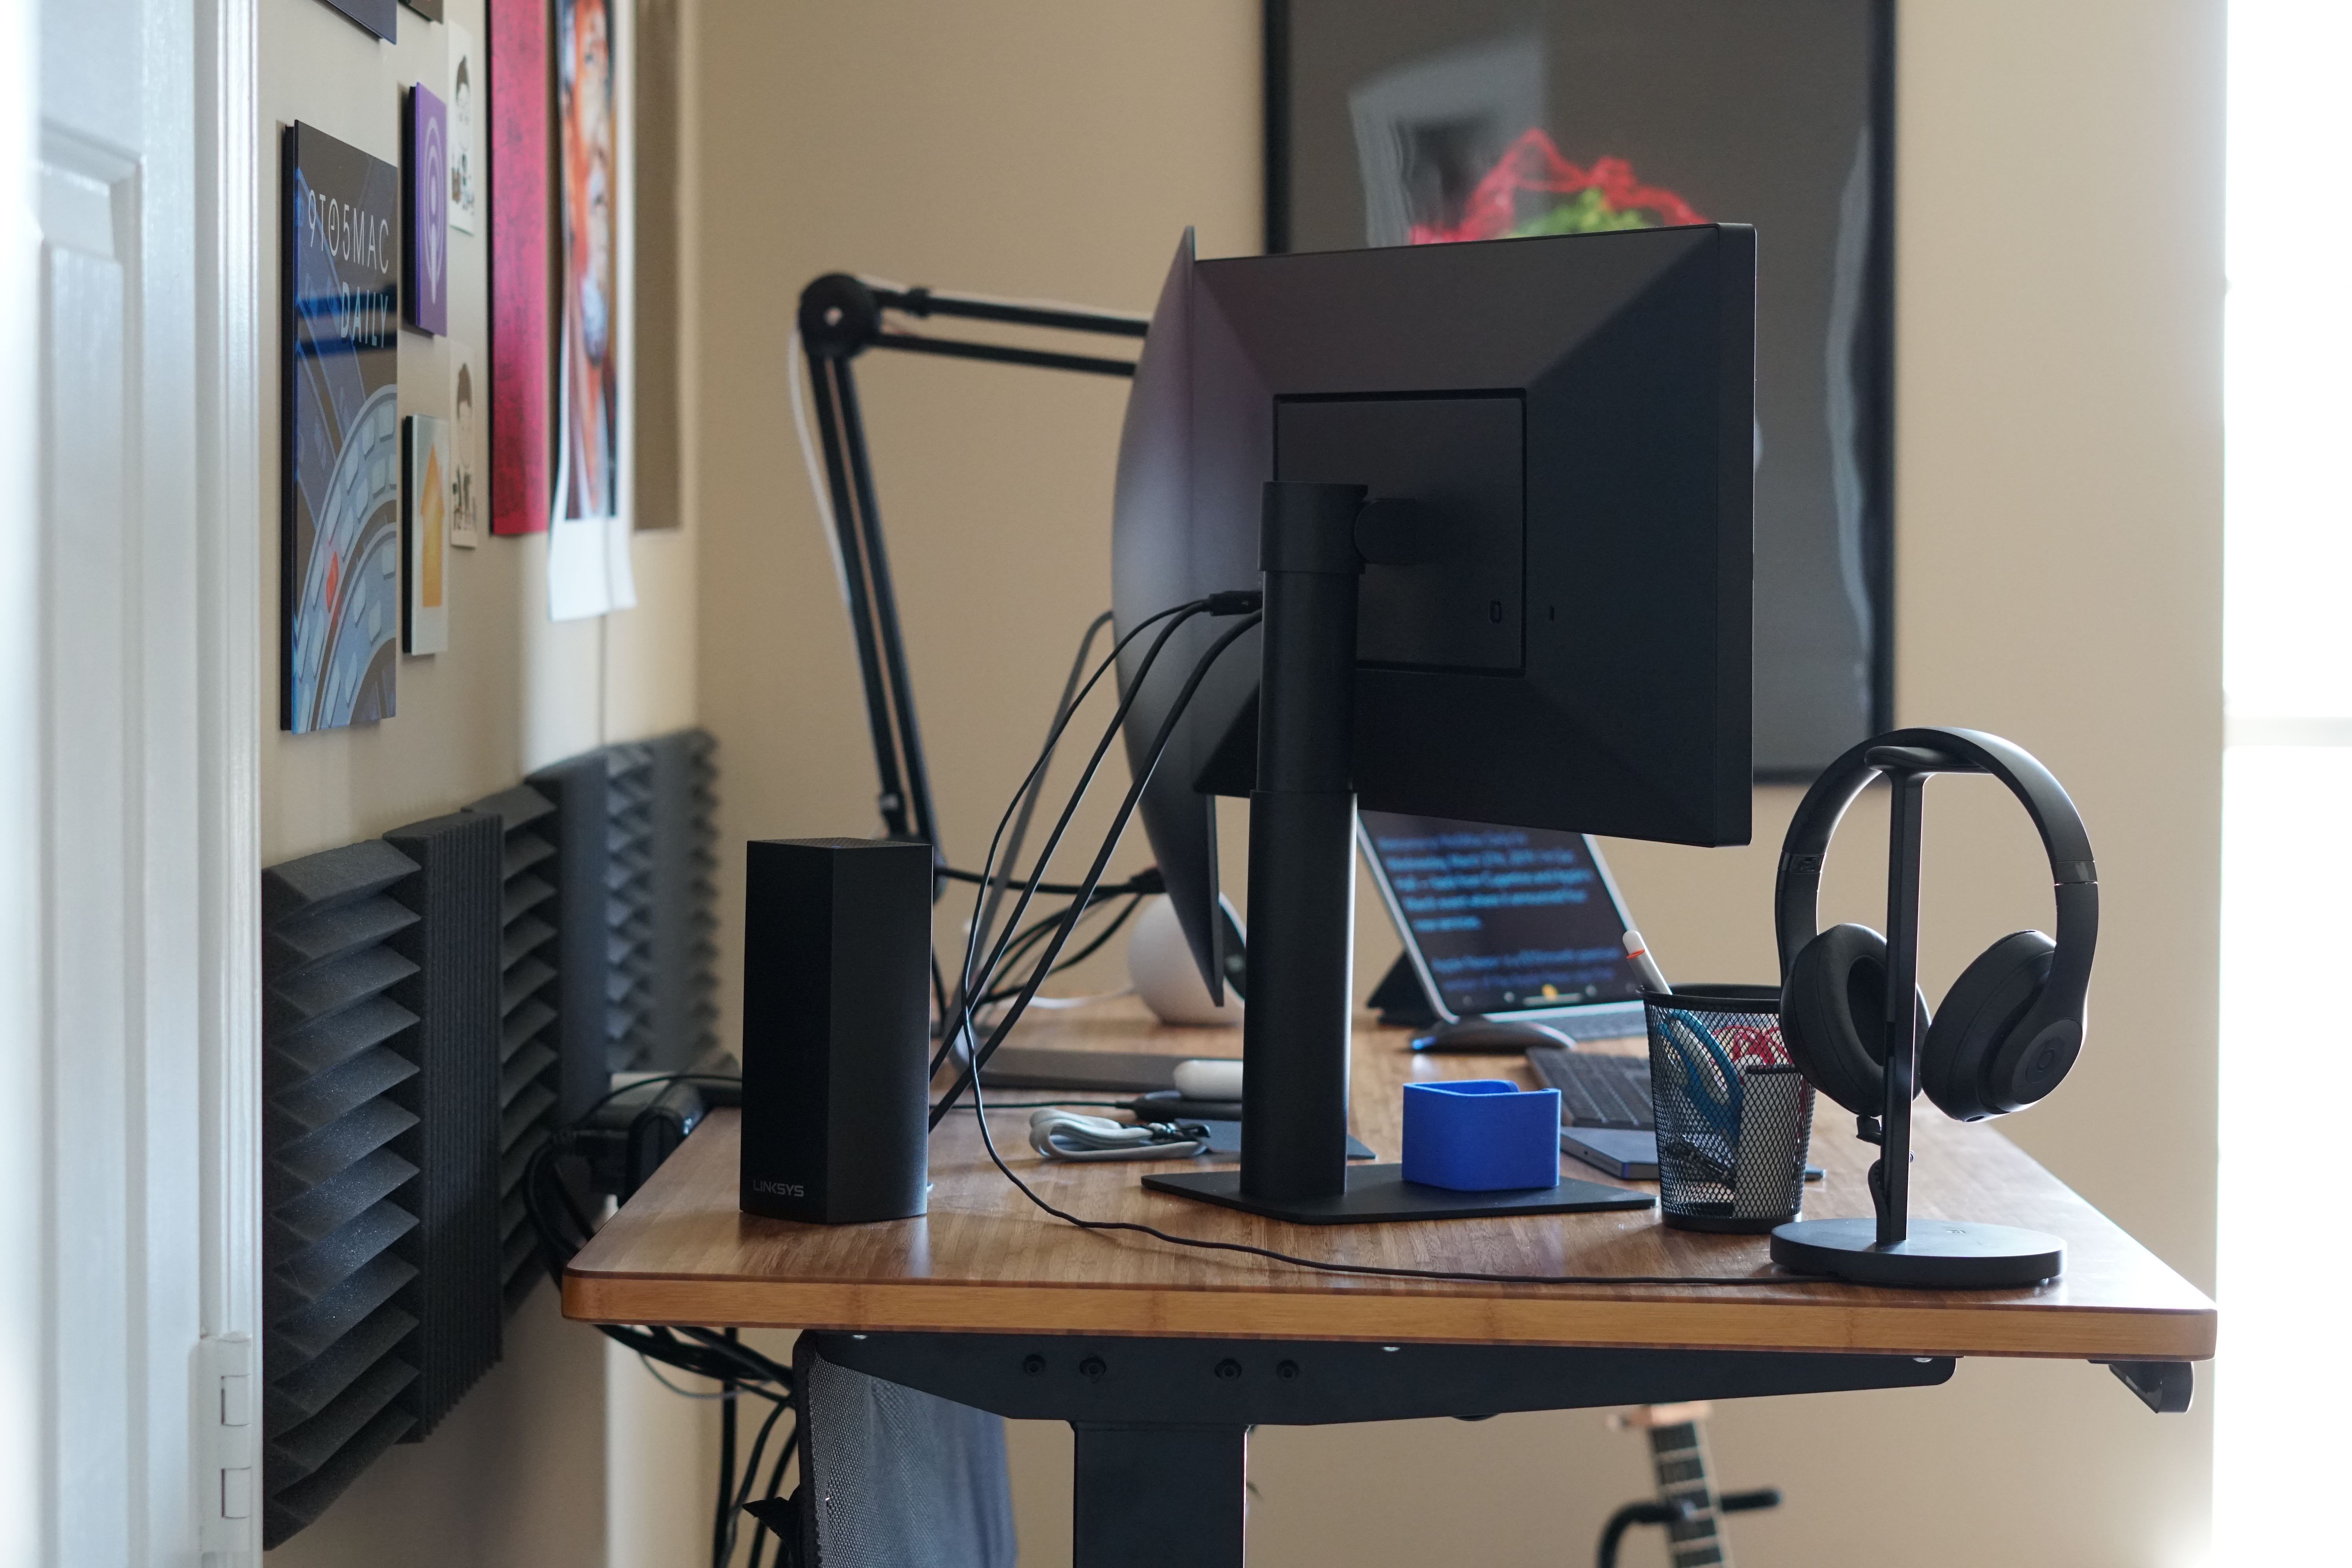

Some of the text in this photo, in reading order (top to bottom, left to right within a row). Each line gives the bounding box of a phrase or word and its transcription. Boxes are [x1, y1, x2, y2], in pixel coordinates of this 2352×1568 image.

[308, 189, 389, 274] 9TO5MAC
[341, 281, 388, 348] DAILY
[753, 1179, 804, 1197] LINKSYS
